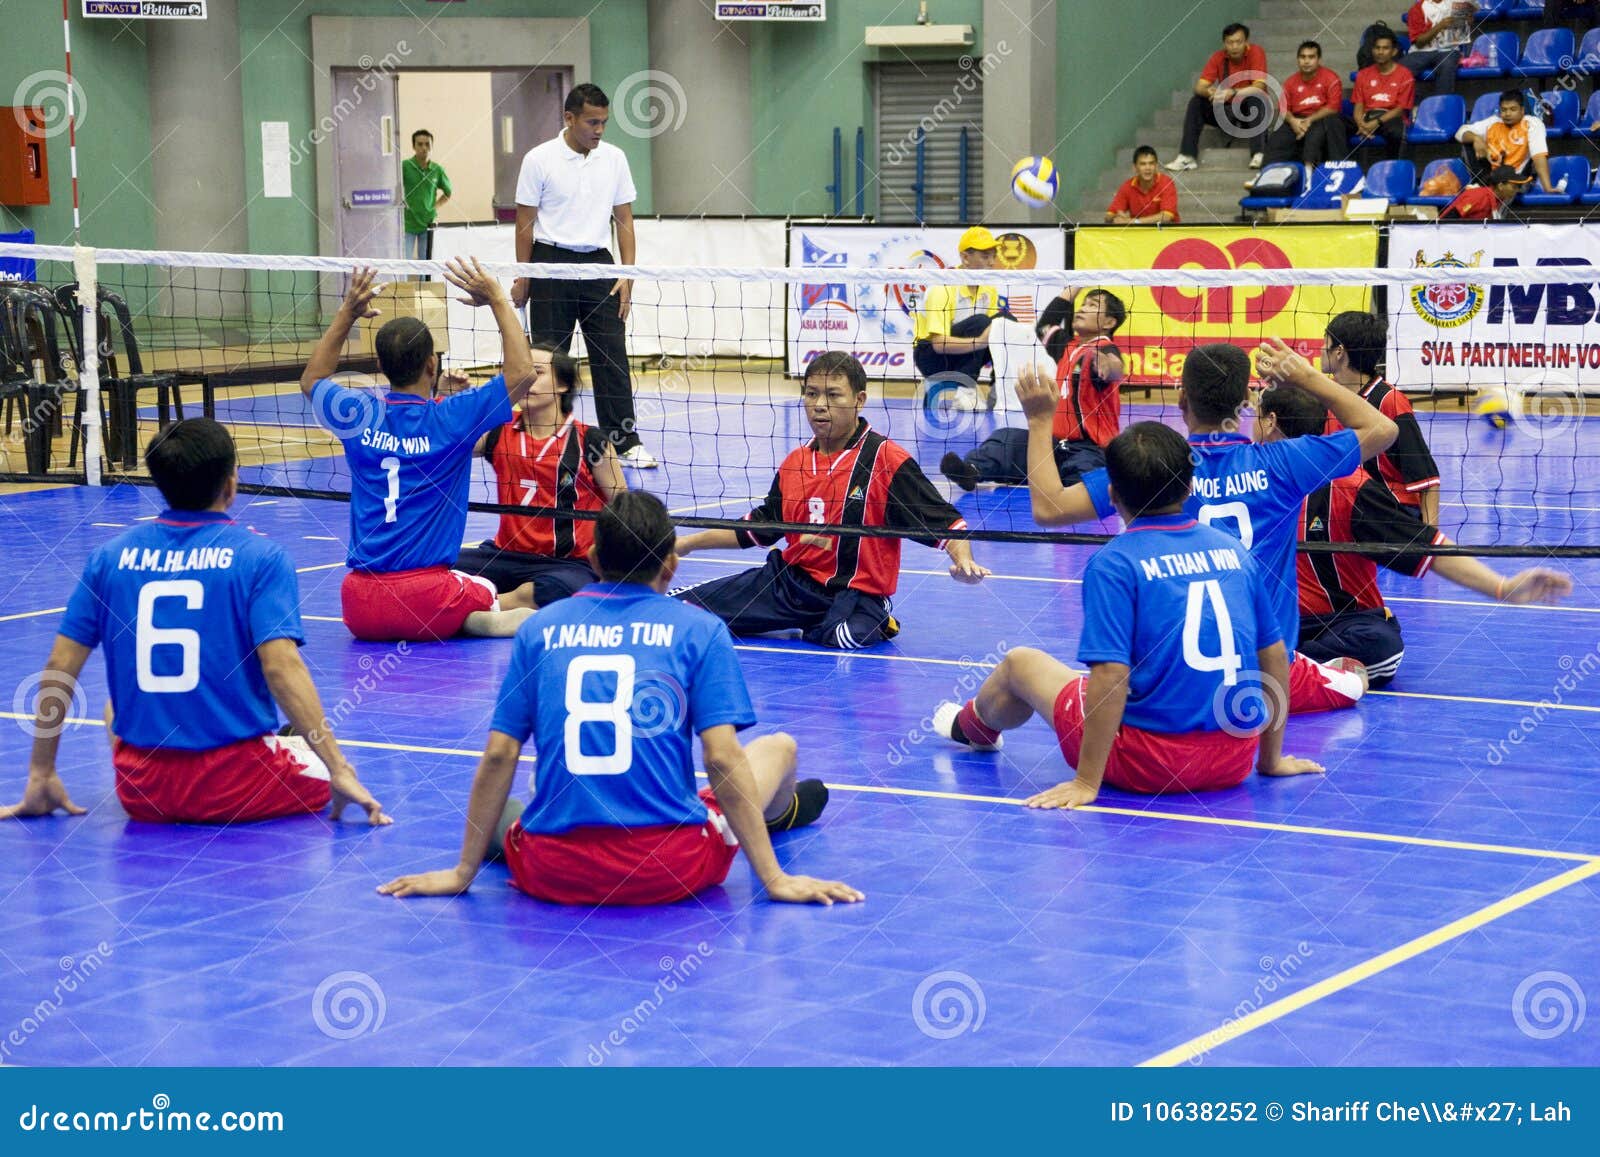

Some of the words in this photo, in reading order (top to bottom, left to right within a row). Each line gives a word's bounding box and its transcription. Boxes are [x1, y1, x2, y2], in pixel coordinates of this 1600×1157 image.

[90, 3, 138, 13] DYNASTY
[143, 3, 187, 16] Pelikan
[721, 6, 764, 16] DYNASTY
[768, 5, 808, 17] Pelikan
[1325, 170, 1345, 193] 3
[1487, 257, 1600, 326] MB
[802, 319, 817, 330] ASIA
[818, 319, 849, 330] OCEANIA
[1421, 341, 1455, 367] SVA
[361, 427, 400, 453] S.HTAY
[402, 436, 430, 455] WIN
[380, 456, 400, 523] 1
[519, 479, 538, 506] 7
[1189, 475, 1222, 499] .MOE
[1225, 469, 1269, 497] AUNG
[118, 547, 234, 573] M.M.HLAING
[1139, 552, 1209, 582] M.THAN
[1209, 548, 1241, 571] WIN
[135, 579, 204, 693] 6
[543, 624, 623, 650] Y.NAING
[630, 622, 674, 648] TUN
[1182, 579, 1242, 687] 4
[564, 654, 636, 776] 8
